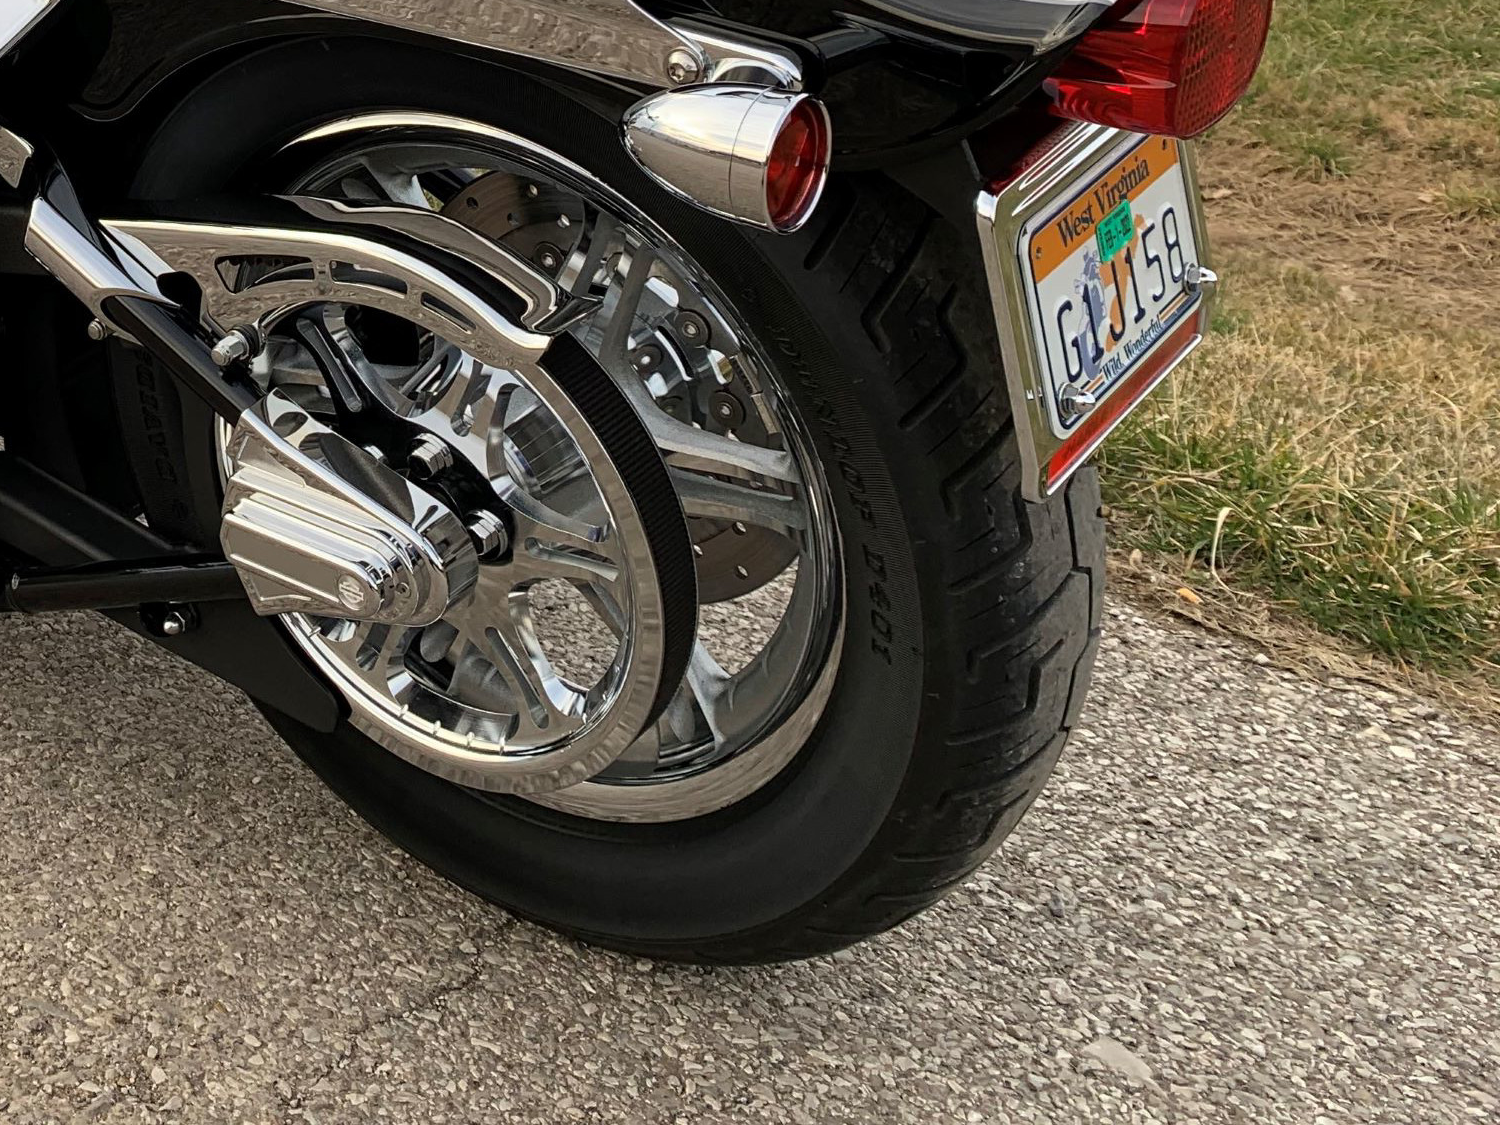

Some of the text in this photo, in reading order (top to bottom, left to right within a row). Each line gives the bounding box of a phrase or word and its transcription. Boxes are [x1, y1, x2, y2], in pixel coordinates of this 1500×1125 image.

[1056, 200, 1096, 249] West
[1093, 155, 1150, 216] Virginia
[1057, 207, 1185, 383] G1J158
[1123, 313, 1164, 361] Wonderful
